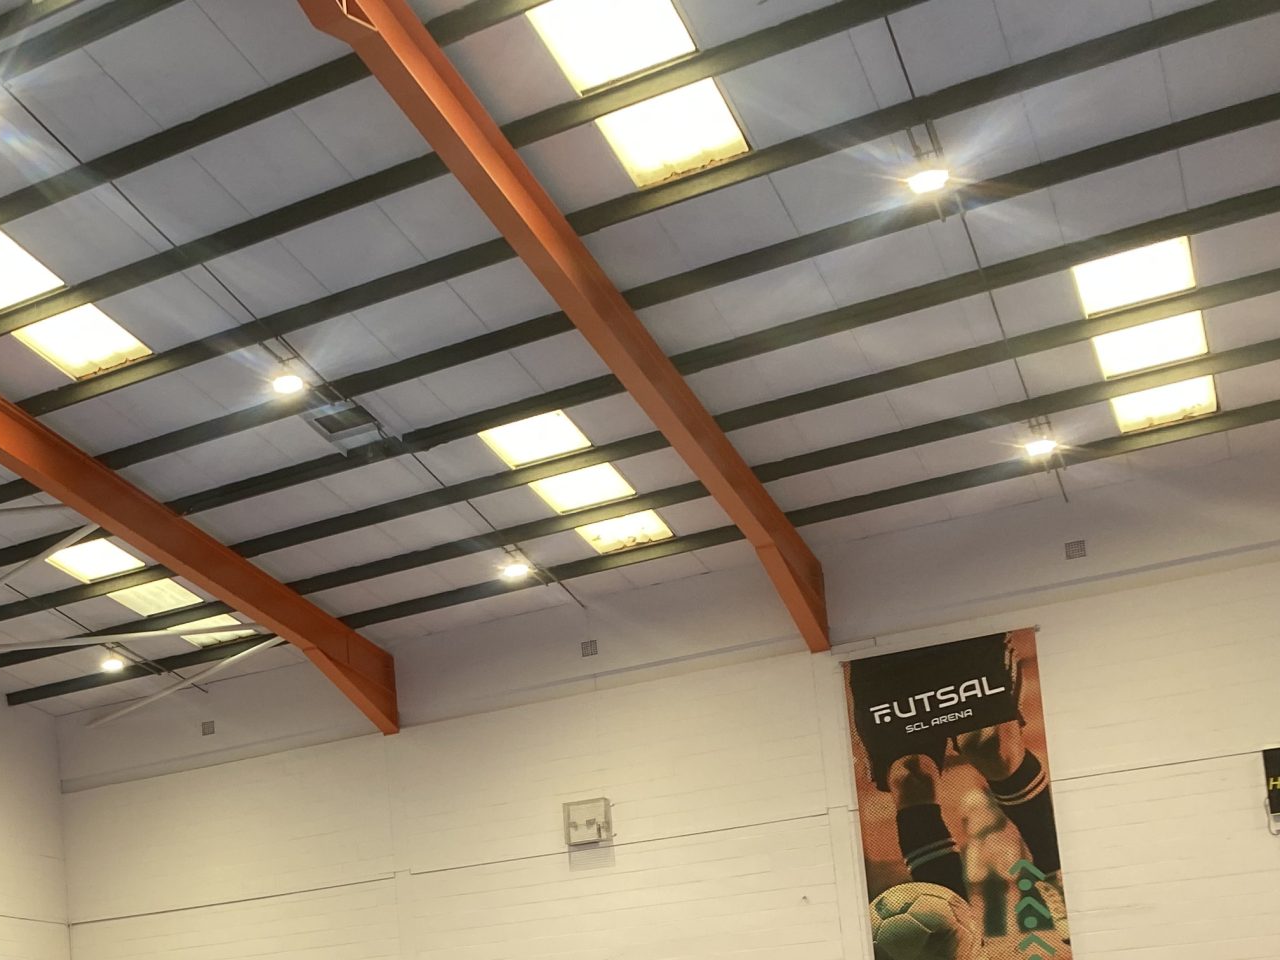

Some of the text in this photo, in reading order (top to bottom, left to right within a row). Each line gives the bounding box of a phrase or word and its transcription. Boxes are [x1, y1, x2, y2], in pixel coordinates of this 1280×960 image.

[869, 676, 1006, 725] FUTSAL
[905, 708, 973, 734] SCL ARENA
